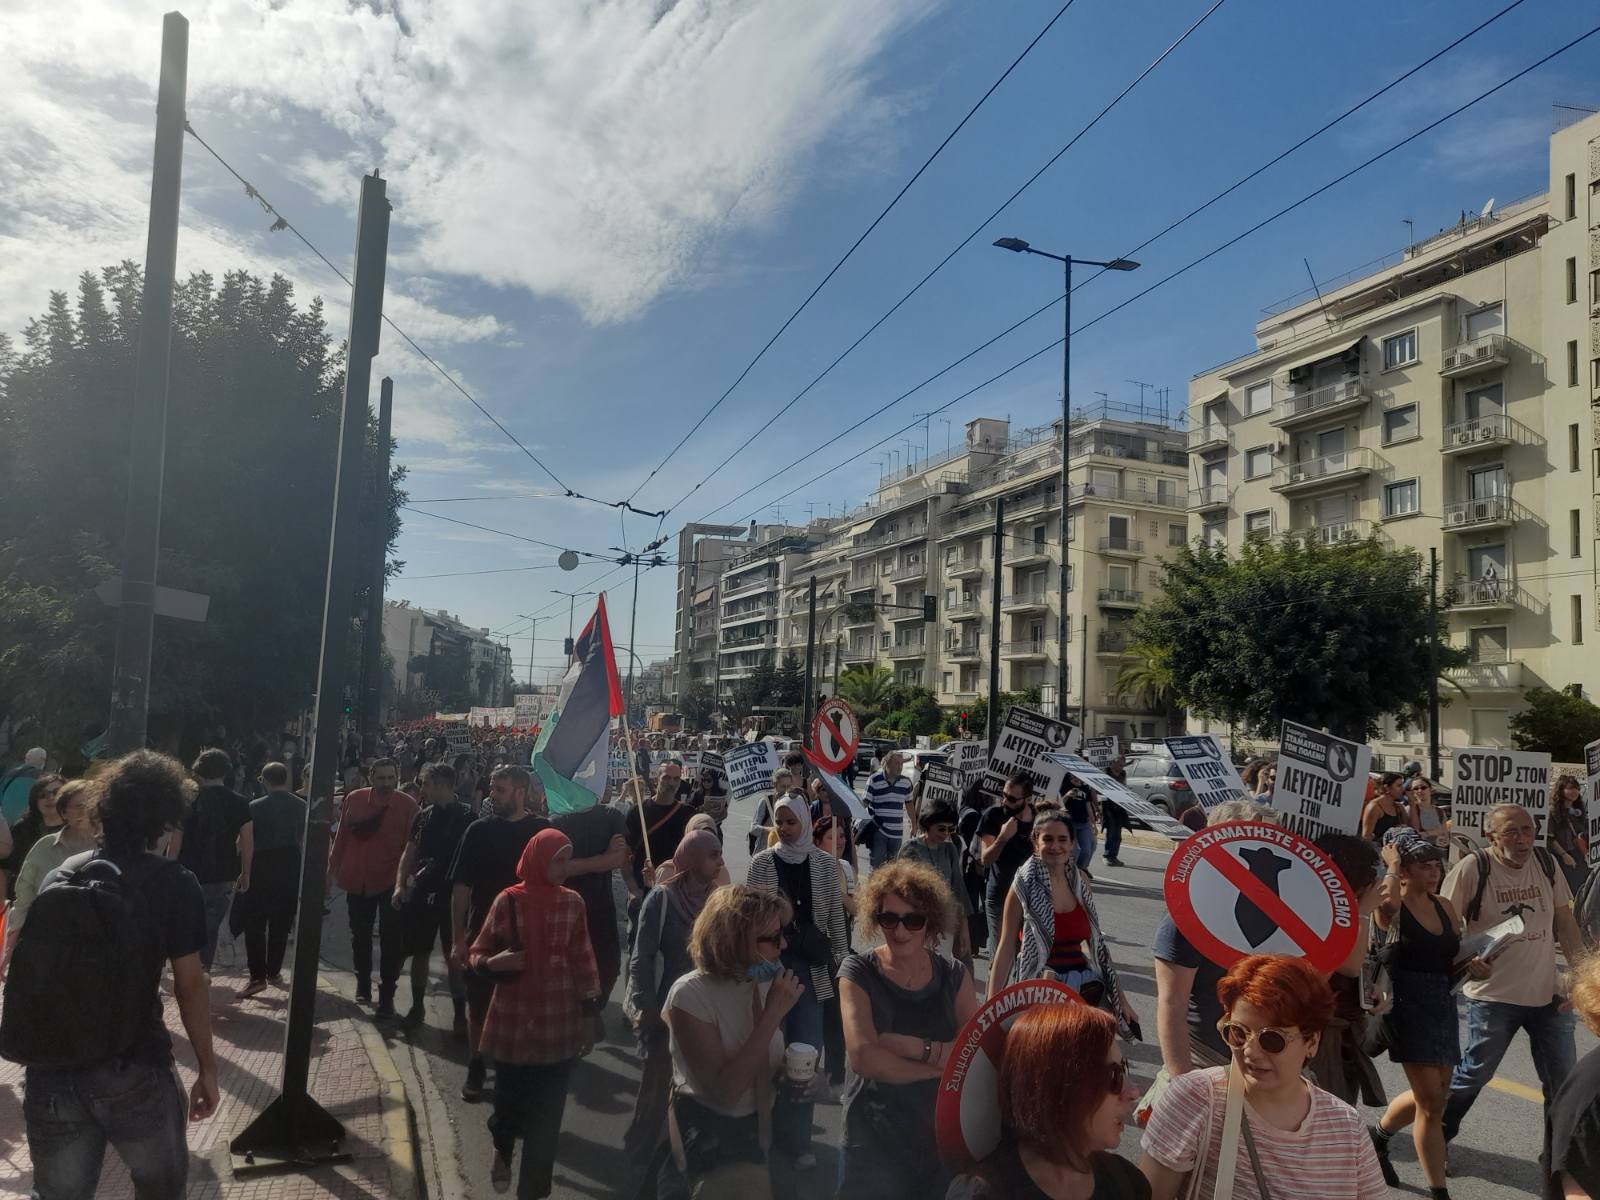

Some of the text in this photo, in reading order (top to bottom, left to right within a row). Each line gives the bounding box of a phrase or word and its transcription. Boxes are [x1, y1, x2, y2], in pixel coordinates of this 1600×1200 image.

[730, 756, 768, 773] ΛΕΥΤΕΡΙΑ
[961, 745, 980, 759] STOP
[989, 758, 1051, 790] ΠΑΛΑΤΙΝΗ
[1458, 754, 1547, 784] STOP ΣΤΟΝ
[1282, 766, 1342, 807] ΛΕΥΤΕΡΙΑ
[1456, 785, 1545, 808] ΑΠΟΚΛΕΙΣΜΟ
[1299, 798, 1321, 819] ΣΤΗΝ
[1456, 810, 1479, 827] ΤΗΣ
[1196, 825, 1294, 849] ΣΤΑΜΑΤΗΣΤΕ
[1295, 842, 1326, 868] ΤΟΝ
[1320, 868, 1352, 928] ΠΟΛΕΜΟ
[945, 986, 1068, 1092] Συμμαχία ΣΤΑΜΑΤΗΣΤΕ
